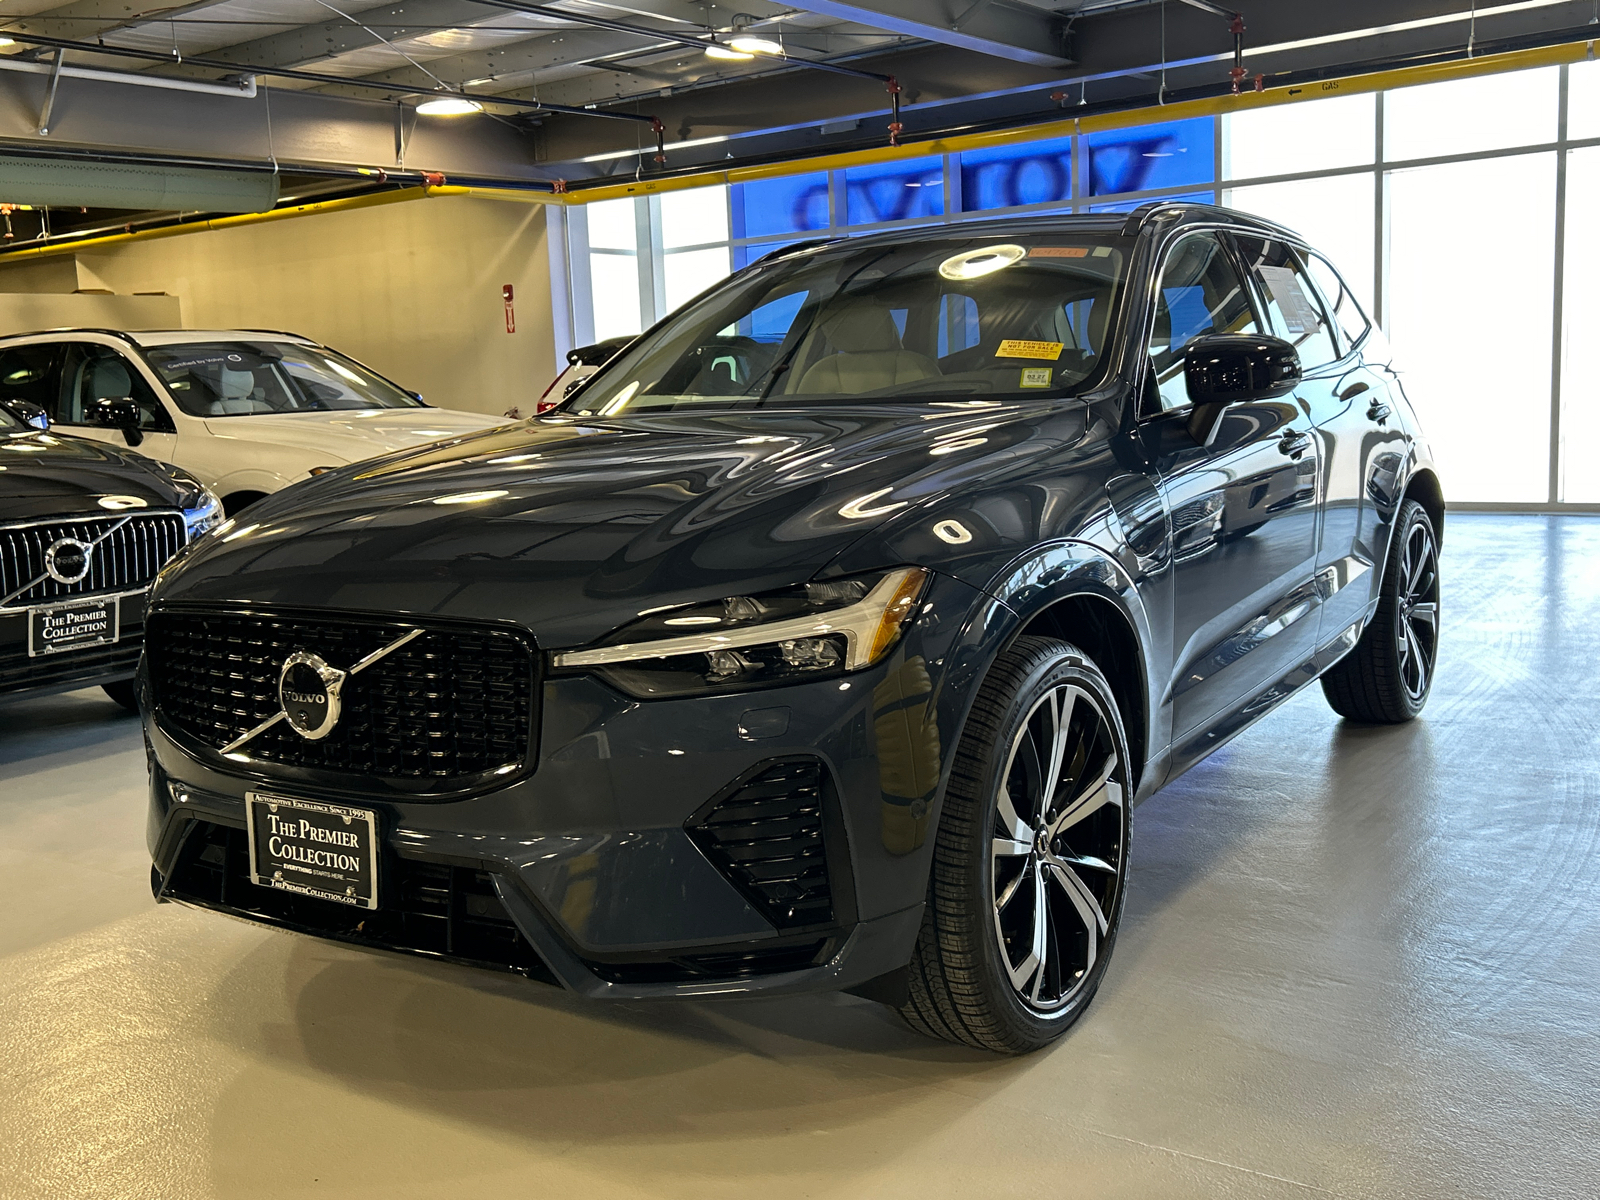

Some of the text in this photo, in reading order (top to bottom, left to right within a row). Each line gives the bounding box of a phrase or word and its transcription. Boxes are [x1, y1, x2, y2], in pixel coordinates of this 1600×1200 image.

[1322, 81, 1339, 91] GAS
[42, 610, 107, 628] THE PREMIER
[42, 621, 107, 639] COLLECTION
[283, 690, 326, 704] VOLVO
[255, 794, 365, 818] AUTOMOTIVE EXCELLENCE SINCE 1995
[267, 814, 360, 848] THE PREMIER
[268, 836, 360, 872] COLLECTION
[283, 863, 312, 874] EVERYTHING
